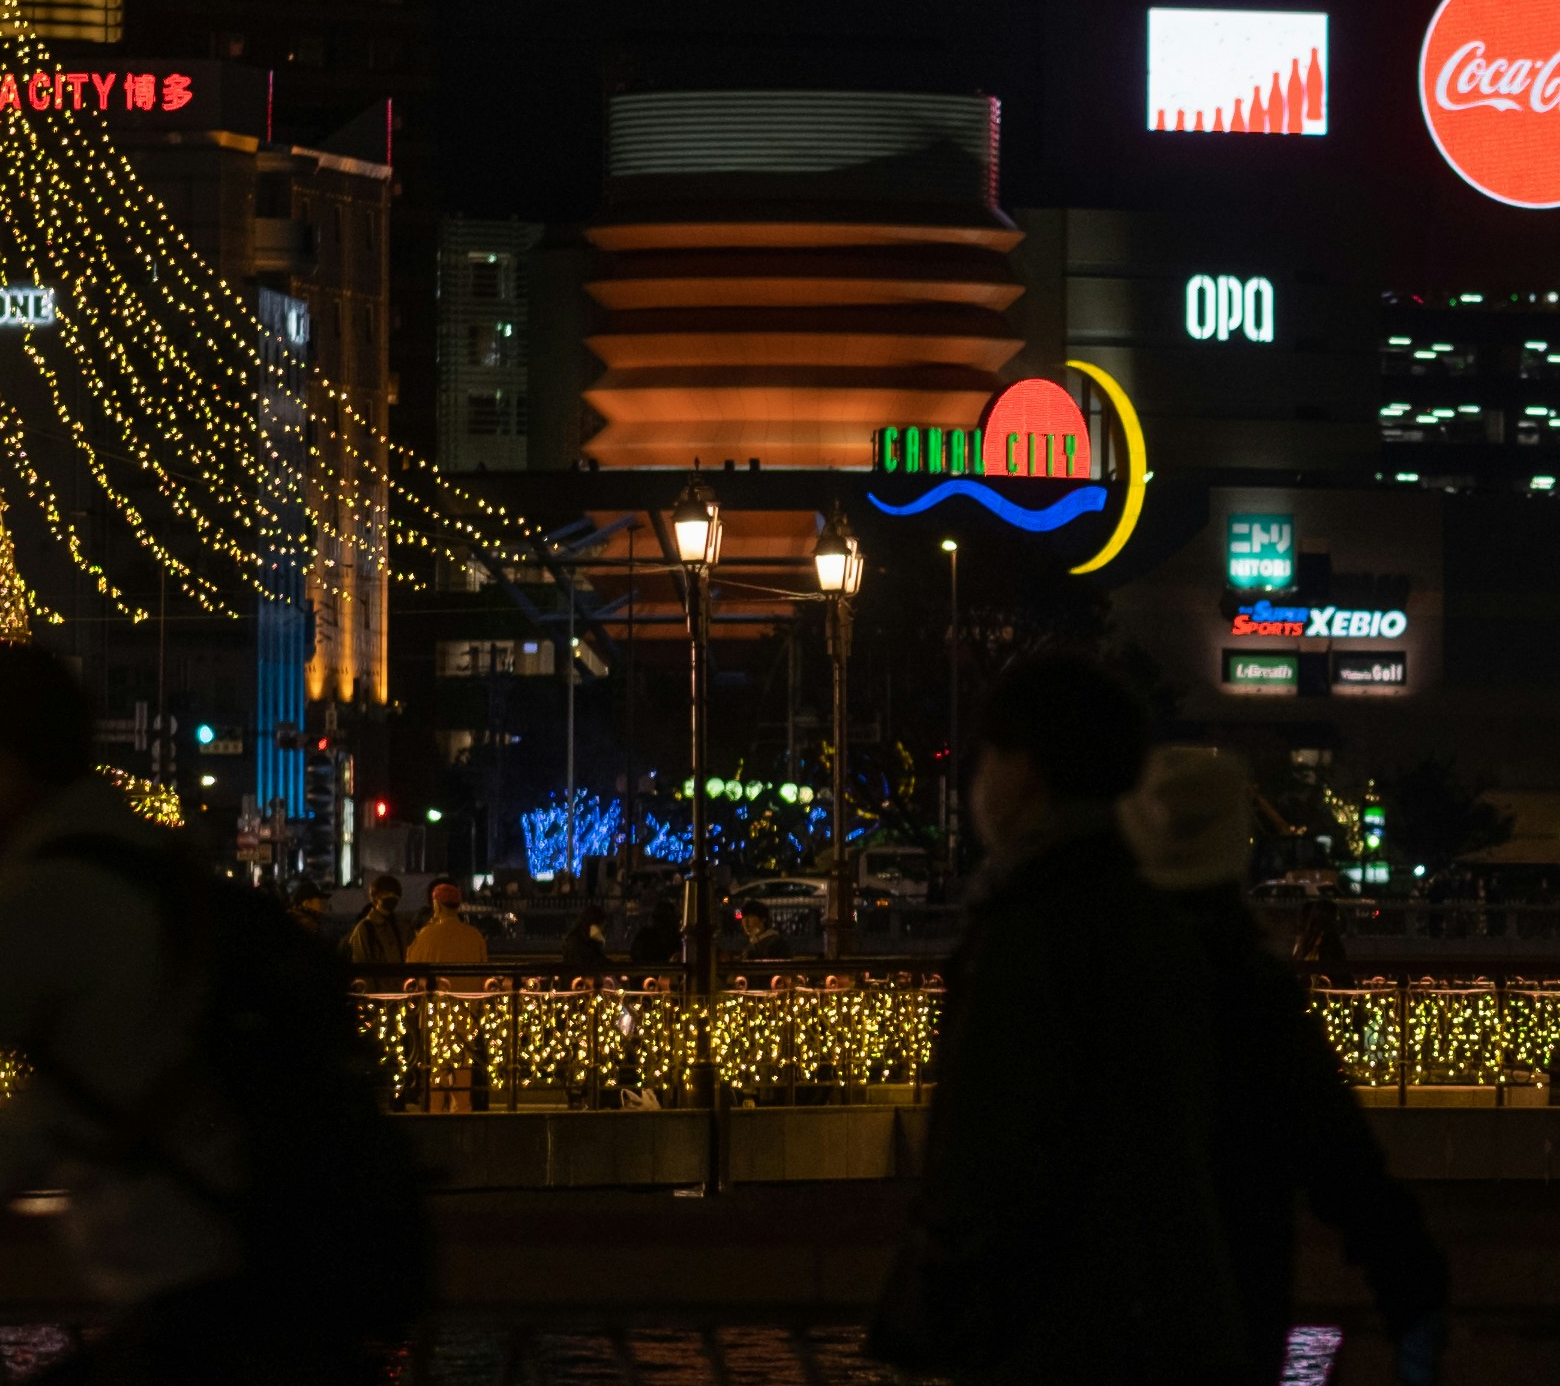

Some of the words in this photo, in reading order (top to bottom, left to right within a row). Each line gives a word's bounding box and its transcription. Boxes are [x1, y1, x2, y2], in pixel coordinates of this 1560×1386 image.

[28, 73, 116, 111] CITY
[123, 73, 193, 111] 博多
[884, 427, 984, 474] CANAL
[1008, 432, 1076, 476] CITY
[1231, 523, 1290, 553] ニトリ
[1305, 606, 1407, 638] XEBIO
